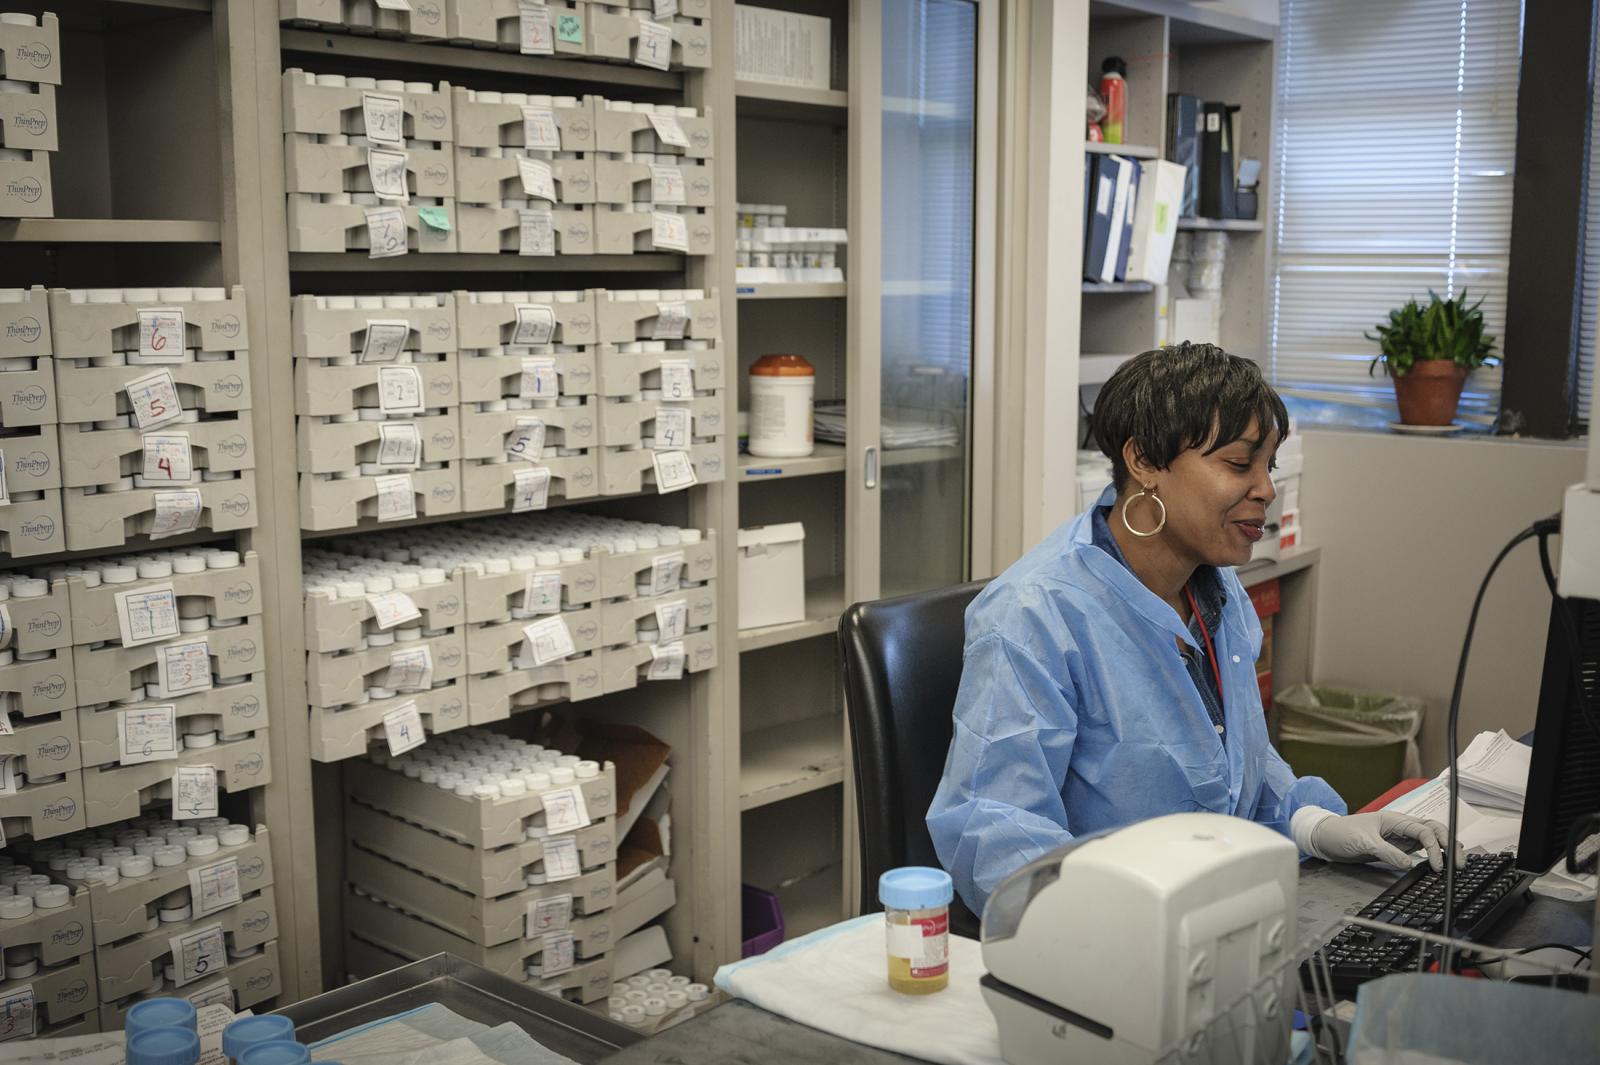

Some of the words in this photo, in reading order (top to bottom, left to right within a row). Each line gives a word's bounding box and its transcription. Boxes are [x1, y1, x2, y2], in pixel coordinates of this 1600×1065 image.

[17, 48, 50, 60] ThinPrep
[15, 116, 46, 127] ThinPrep
[7, 184, 40, 195] ThinPrep
[7, 325, 40, 336] ThinPrep
[151, 327, 167, 351] 6
[13, 393, 45, 404] ThinPrep
[150, 398, 165, 417] 5
[664, 429, 675, 446] 4
[511, 436, 531, 453] 5
[16, 460, 48, 469] ThinPrep
[158, 457, 172, 480] 4
[21, 524, 52, 534] ThinPrep
[28, 620, 60, 630] ThinPrep
[33, 683, 65, 693] ThinPrep
[400, 723, 410, 742] 4
[38, 744, 69, 755] ThinPrep
[43, 803, 75, 816] ThinPrep
[194, 954, 210, 973] 5
